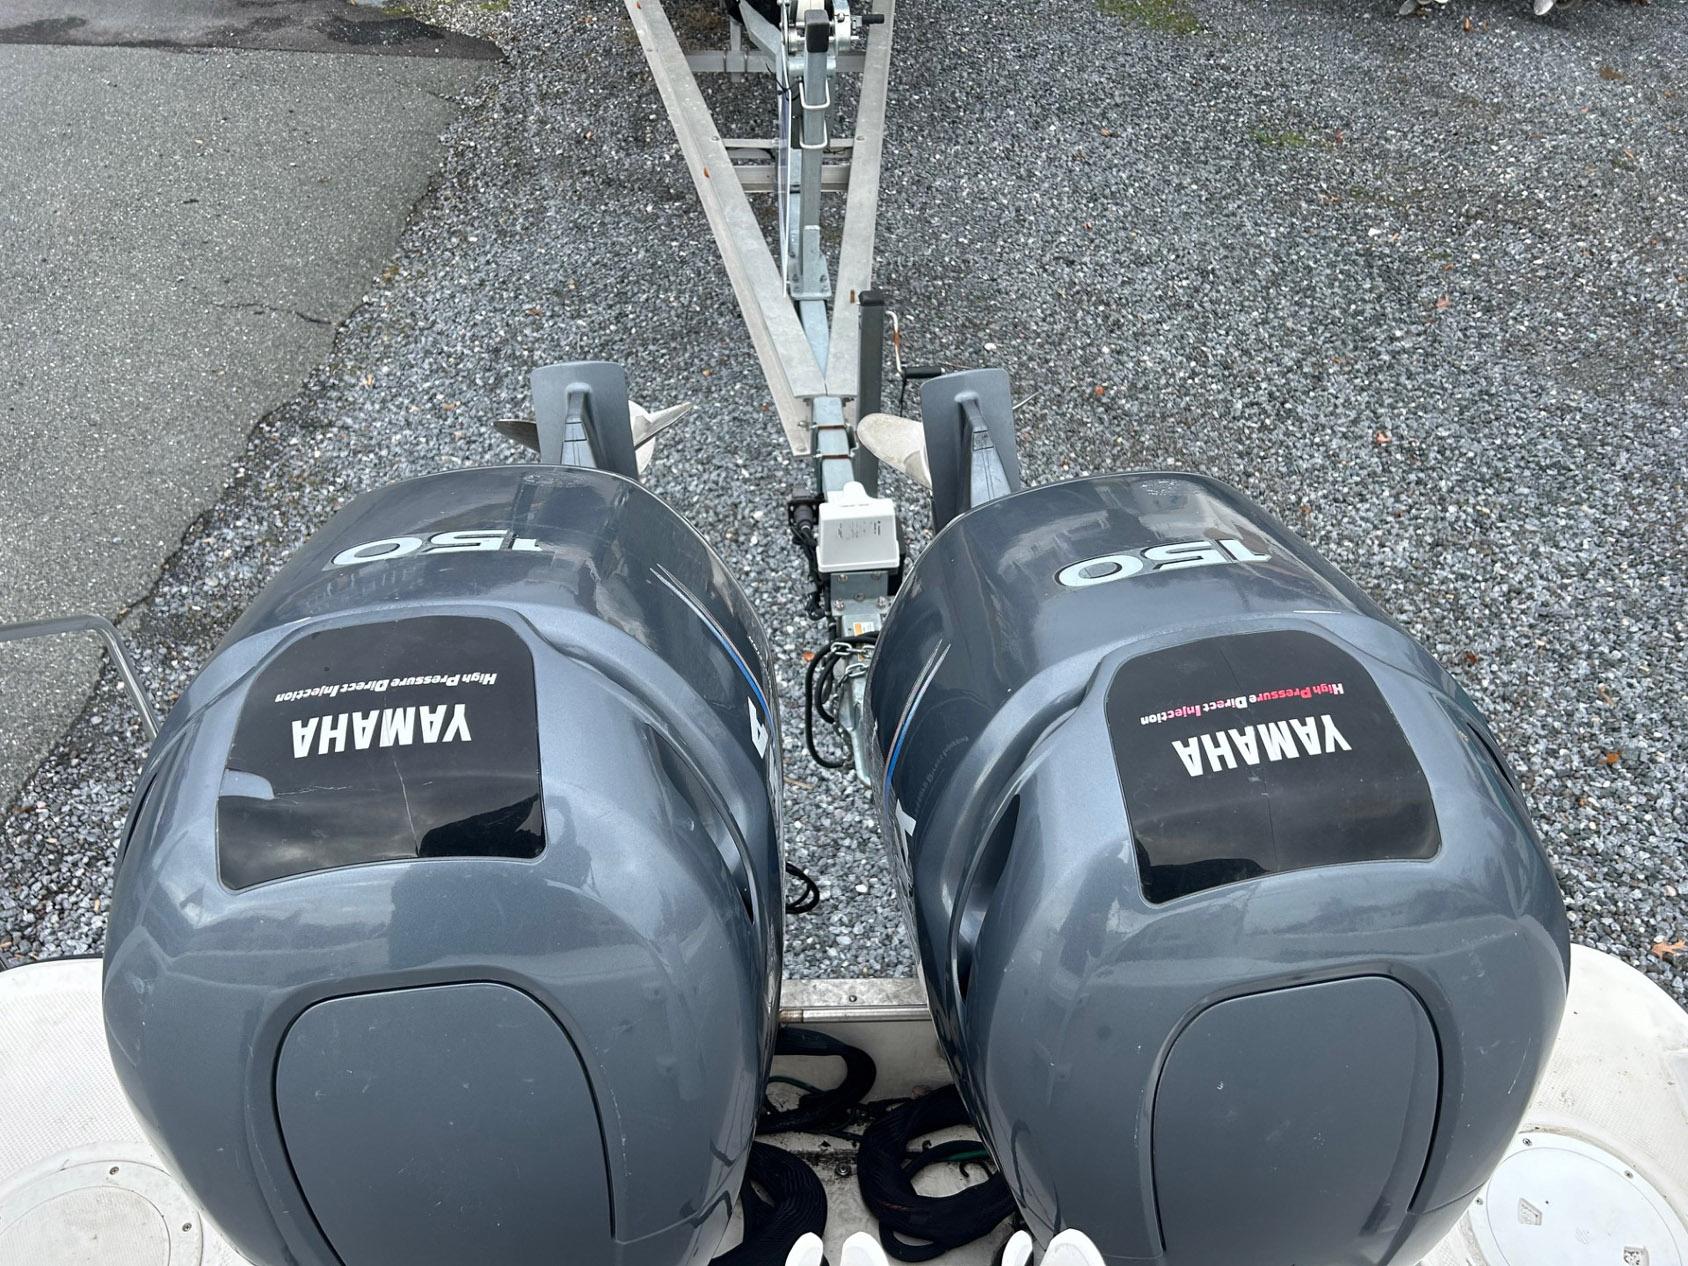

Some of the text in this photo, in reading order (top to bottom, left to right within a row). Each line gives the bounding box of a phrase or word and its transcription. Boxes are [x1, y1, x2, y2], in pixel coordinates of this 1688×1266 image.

[330, 528, 543, 566] 150
[1054, 538, 1272, 588] 150
[274, 672, 498, 704] High Pressure Direct Injection
[1140, 681, 1344, 727] High Pressure Direct Injection
[291, 703, 472, 759] YAMAHA
[1171, 714, 1352, 777] YAMAHA
